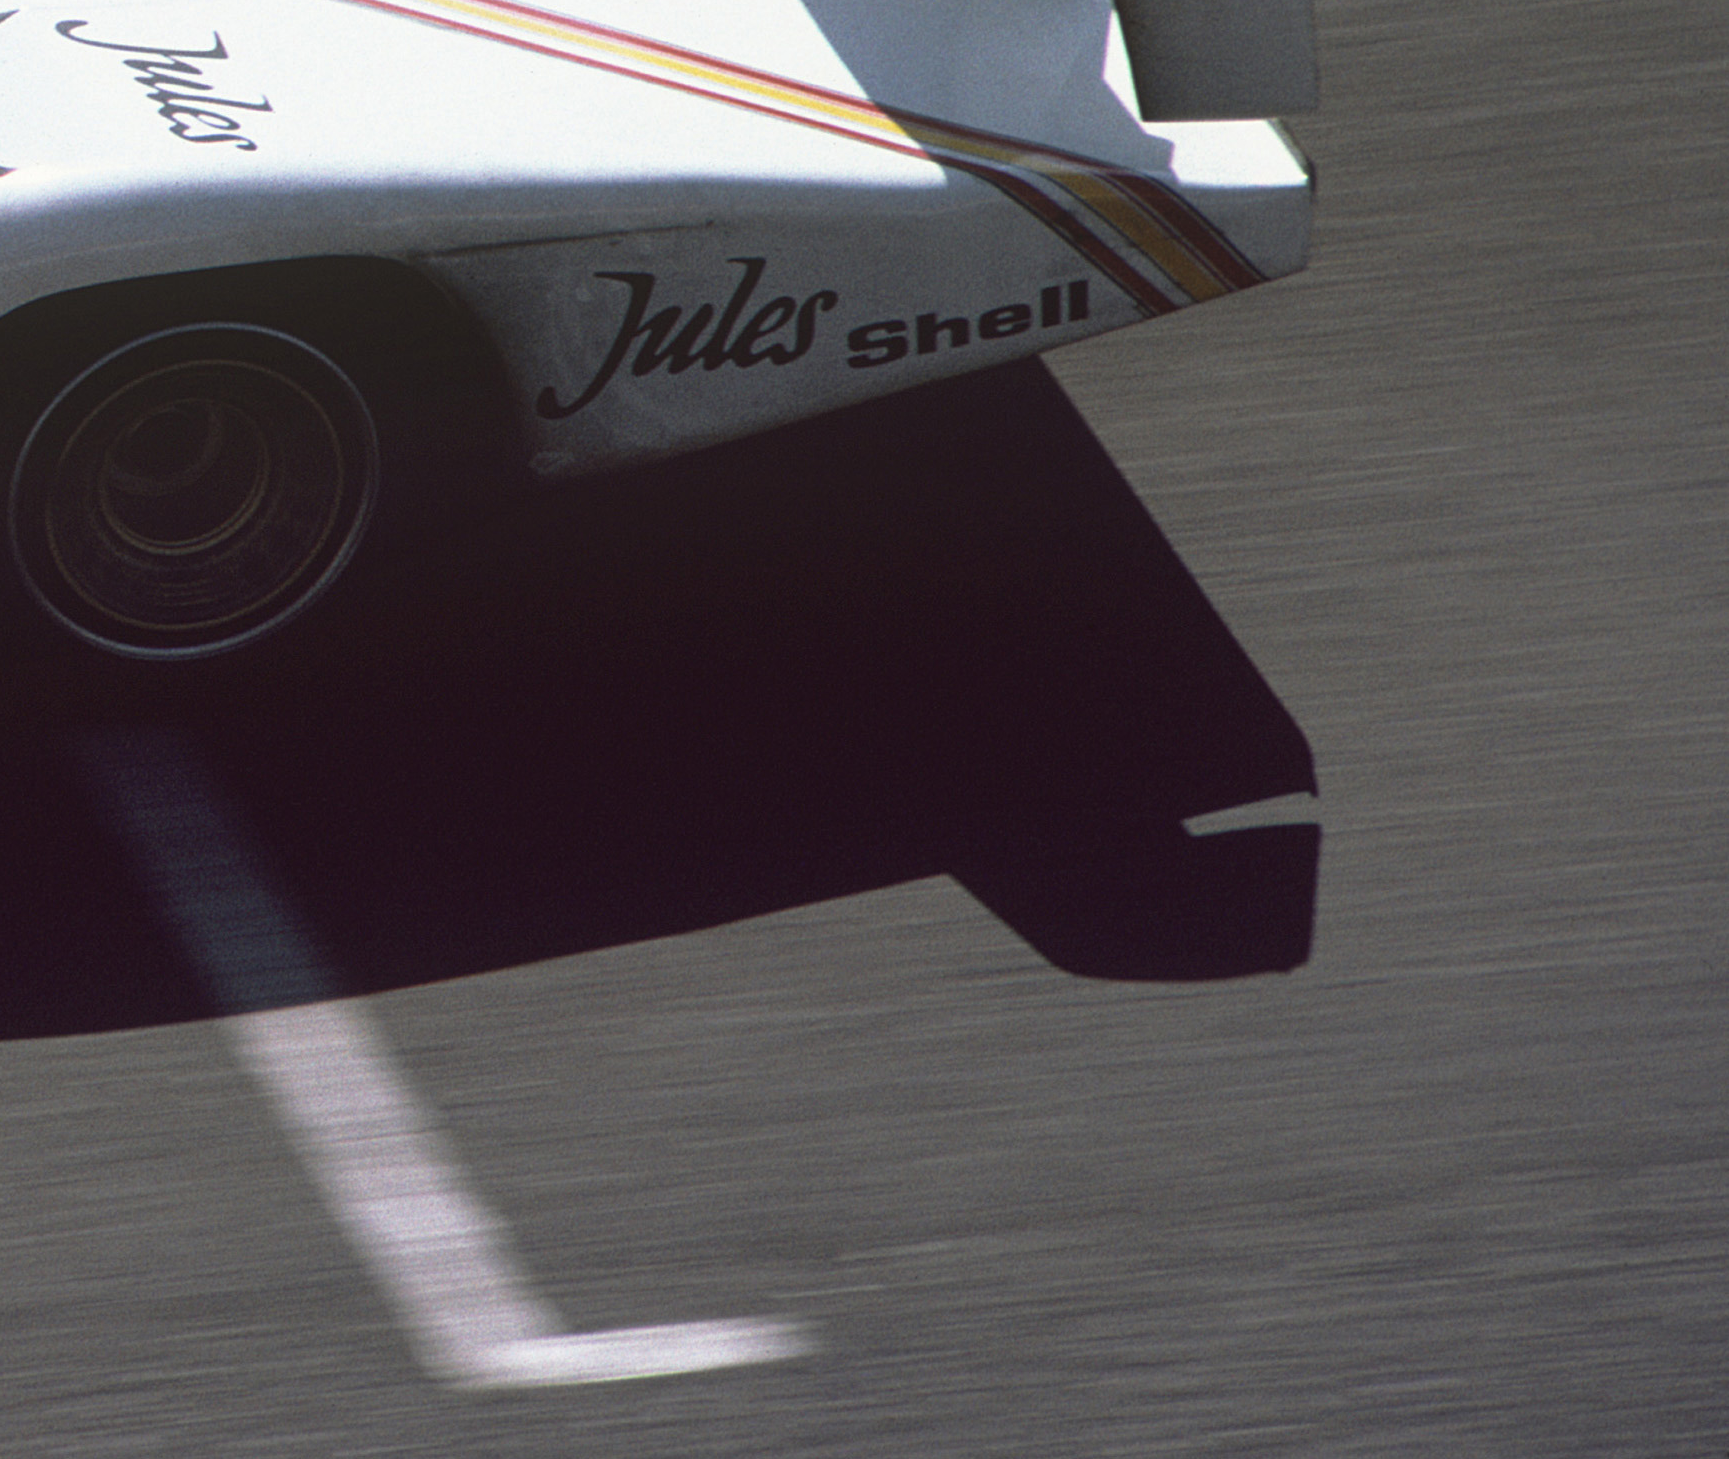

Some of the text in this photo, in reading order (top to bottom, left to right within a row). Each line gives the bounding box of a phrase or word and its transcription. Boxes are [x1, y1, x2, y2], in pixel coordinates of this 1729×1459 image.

[54, 19, 273, 152] Jules
[535, 257, 1090, 421] Jules Shell
